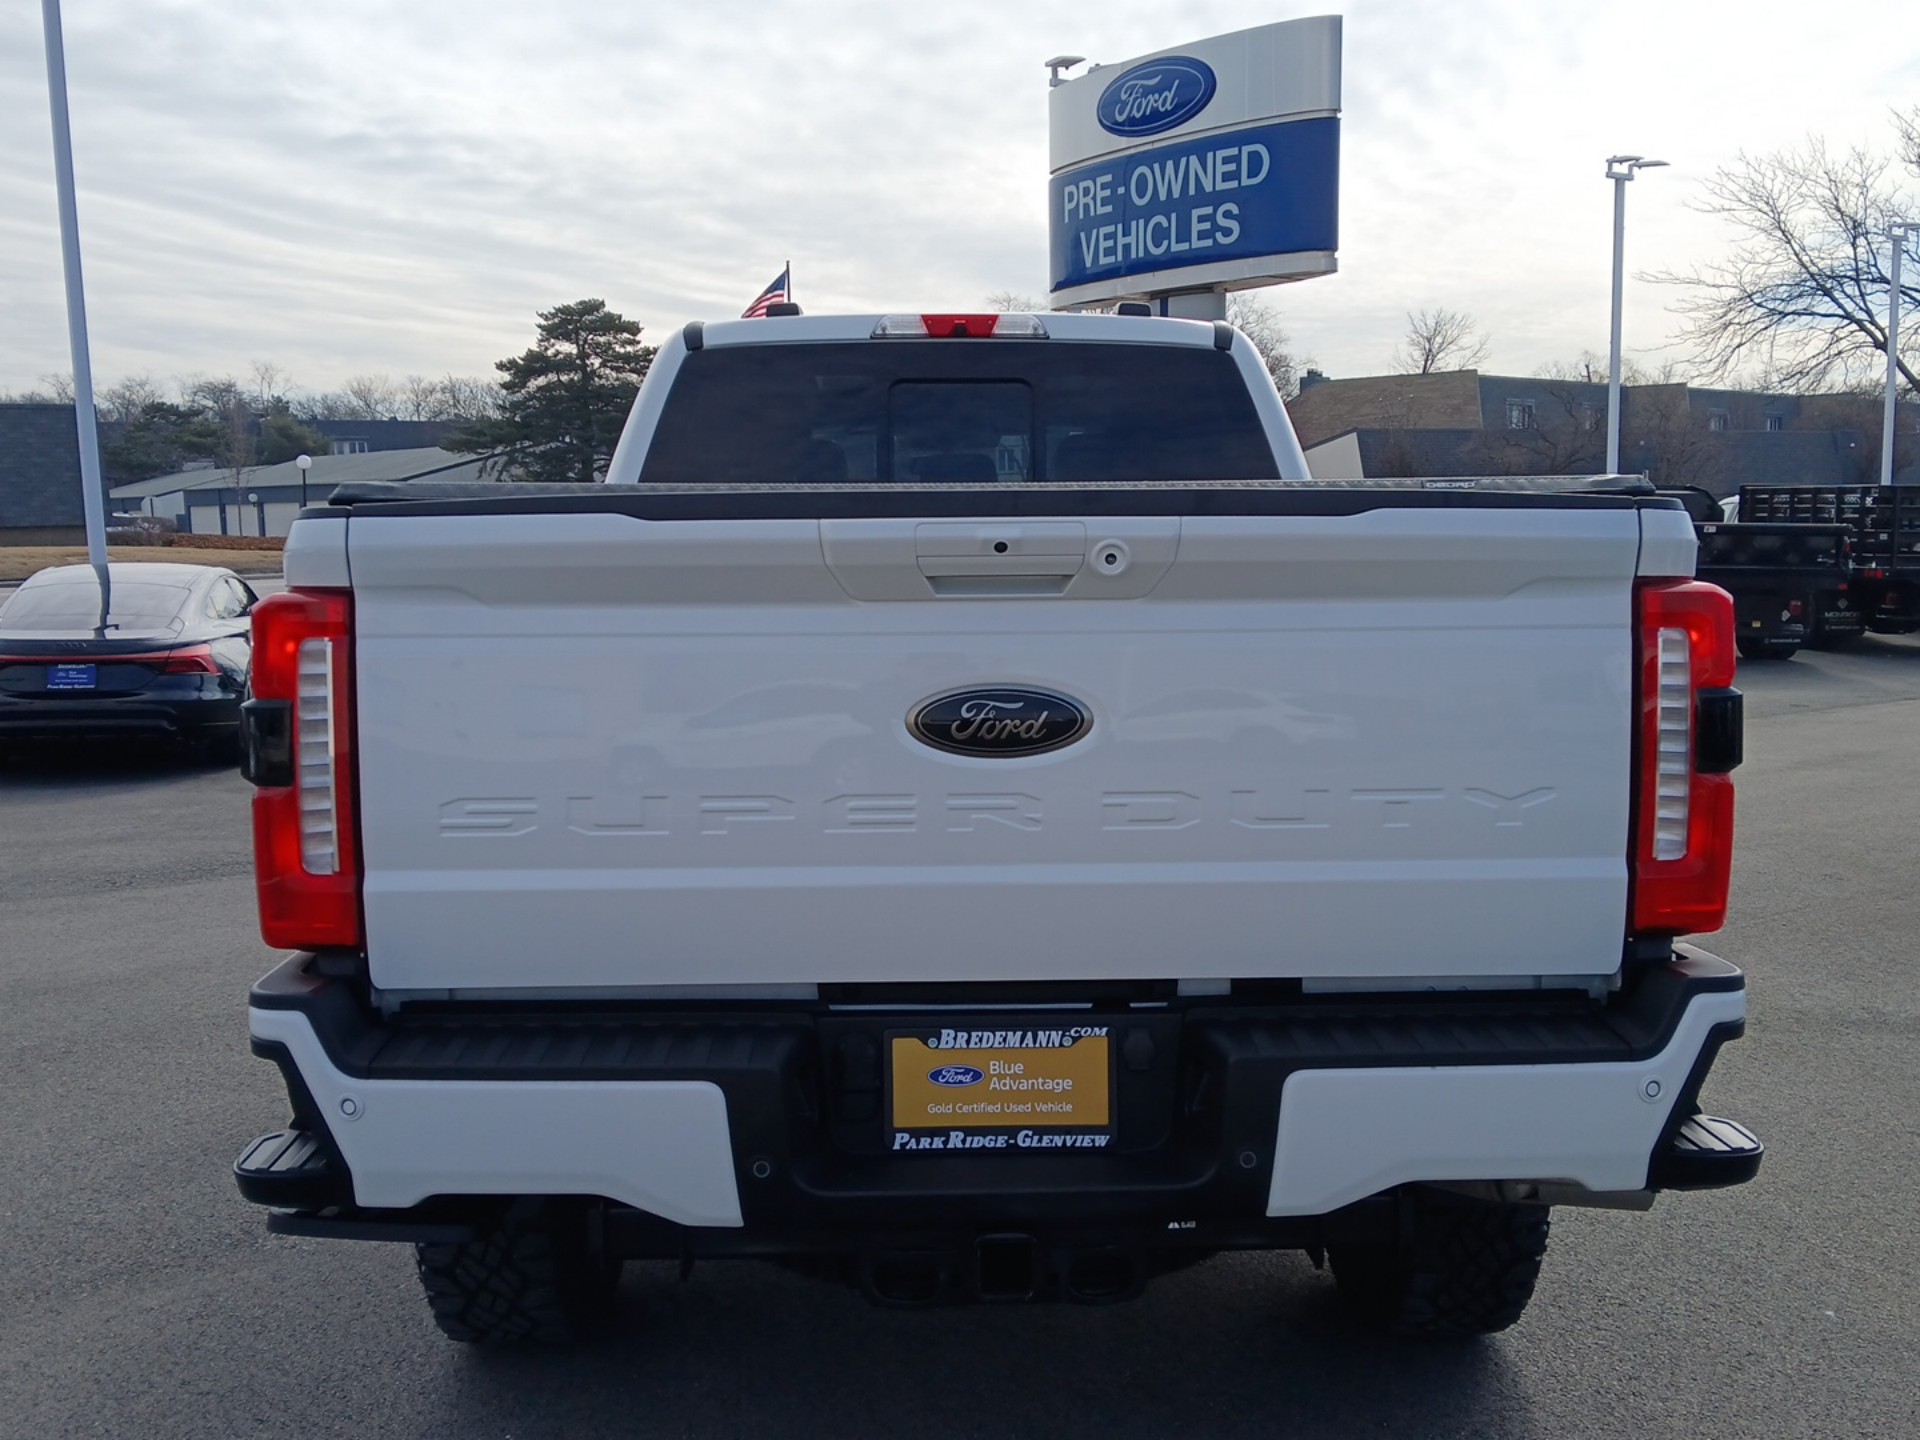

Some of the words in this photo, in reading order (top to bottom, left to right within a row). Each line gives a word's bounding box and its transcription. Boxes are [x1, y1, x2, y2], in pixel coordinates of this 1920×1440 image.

[1115, 75, 1179, 123] Ford
[1063, 143, 1271, 224] PRE-OWNED
[1079, 202, 1241, 269] VEHICLES
[951, 699, 1049, 740] Ford
[438, 791, 1043, 838] SUPER
[1102, 785, 1558, 831] DUTY
[938, 1067, 973, 1084] Ford
[989, 1061, 1024, 1074] Blue
[988, 1077, 1073, 1093] Advantage
[927, 1103, 953, 1114] Gold
[955, 1102, 1001, 1113] Certified
[1004, 1102, 1032, 1113] Used
[1034, 1101, 1073, 1113] Vehicle
[892, 1132, 946, 1150] PARK
